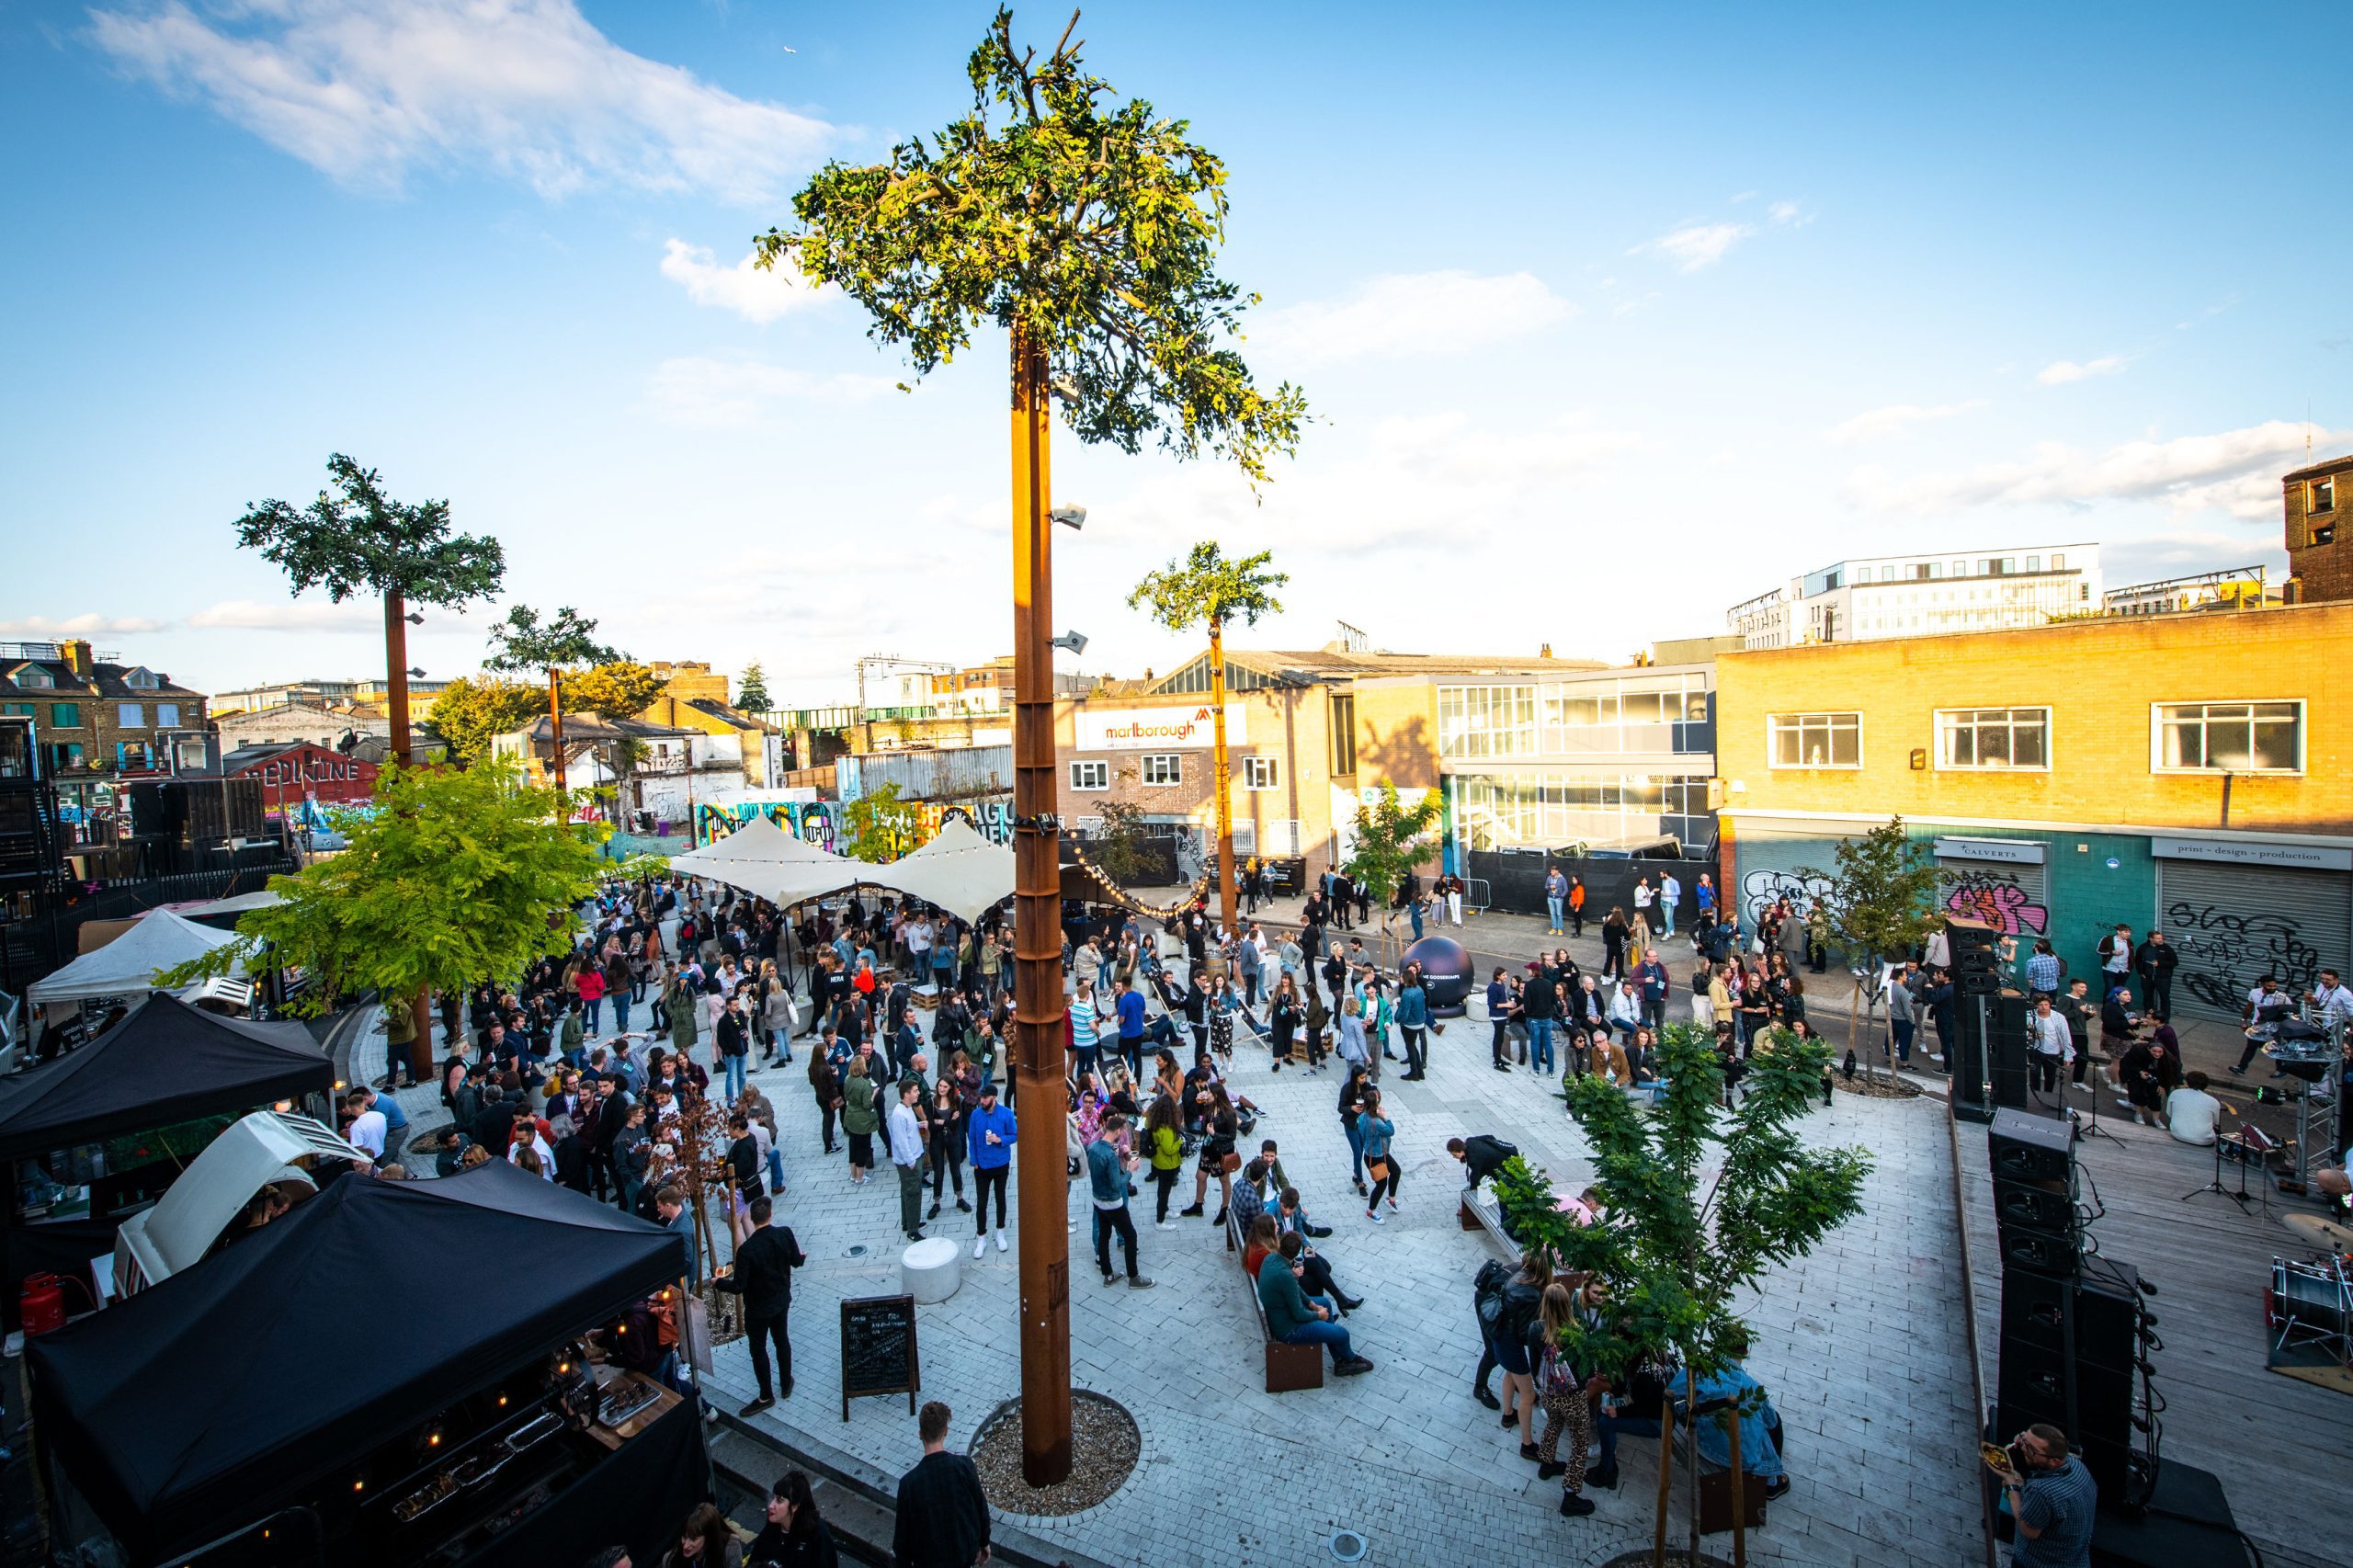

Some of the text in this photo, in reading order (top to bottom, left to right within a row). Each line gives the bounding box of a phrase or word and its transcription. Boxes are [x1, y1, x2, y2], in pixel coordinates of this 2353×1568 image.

[1106, 721, 1195, 740] marlborough
[1964, 848, 2017, 858] CALVERTS
[2177, 845, 2203, 854] print
[2214, 846, 2247, 858] design
[2259, 851, 2321, 861] production
